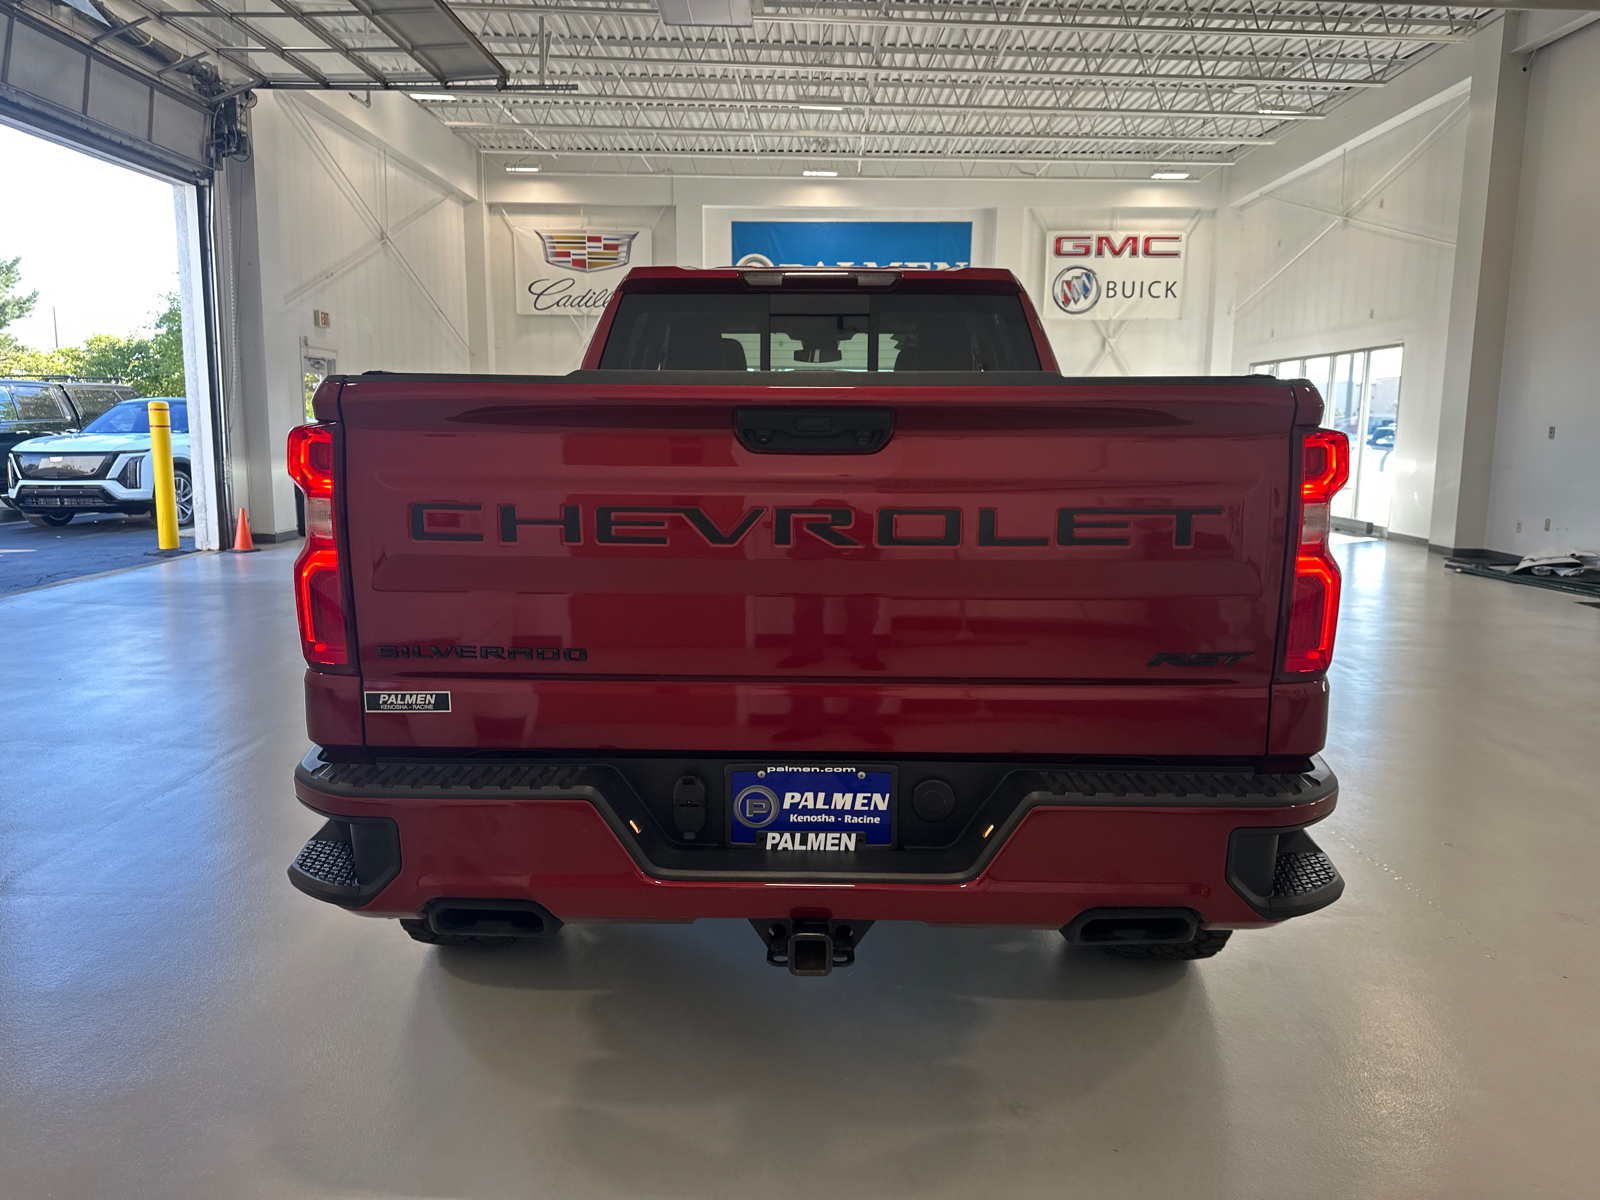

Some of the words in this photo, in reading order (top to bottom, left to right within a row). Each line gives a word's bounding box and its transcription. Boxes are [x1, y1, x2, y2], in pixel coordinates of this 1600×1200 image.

[1053, 235, 1182, 258] GMC
[528, 278, 614, 311] Cadill
[1106, 281, 1178, 298] BUICK
[410, 503, 1223, 548] CHEVROLET
[376, 645, 588, 662] SILVERADO
[1147, 652, 1256, 667] RST
[379, 694, 436, 705] PALMEN
[767, 765, 856, 774] palmen.com
[782, 792, 890, 811] PALMEN
[789, 813, 835, 823] Kenosha
[844, 815, 881, 824] Racine
[765, 832, 856, 851] PALMEN
